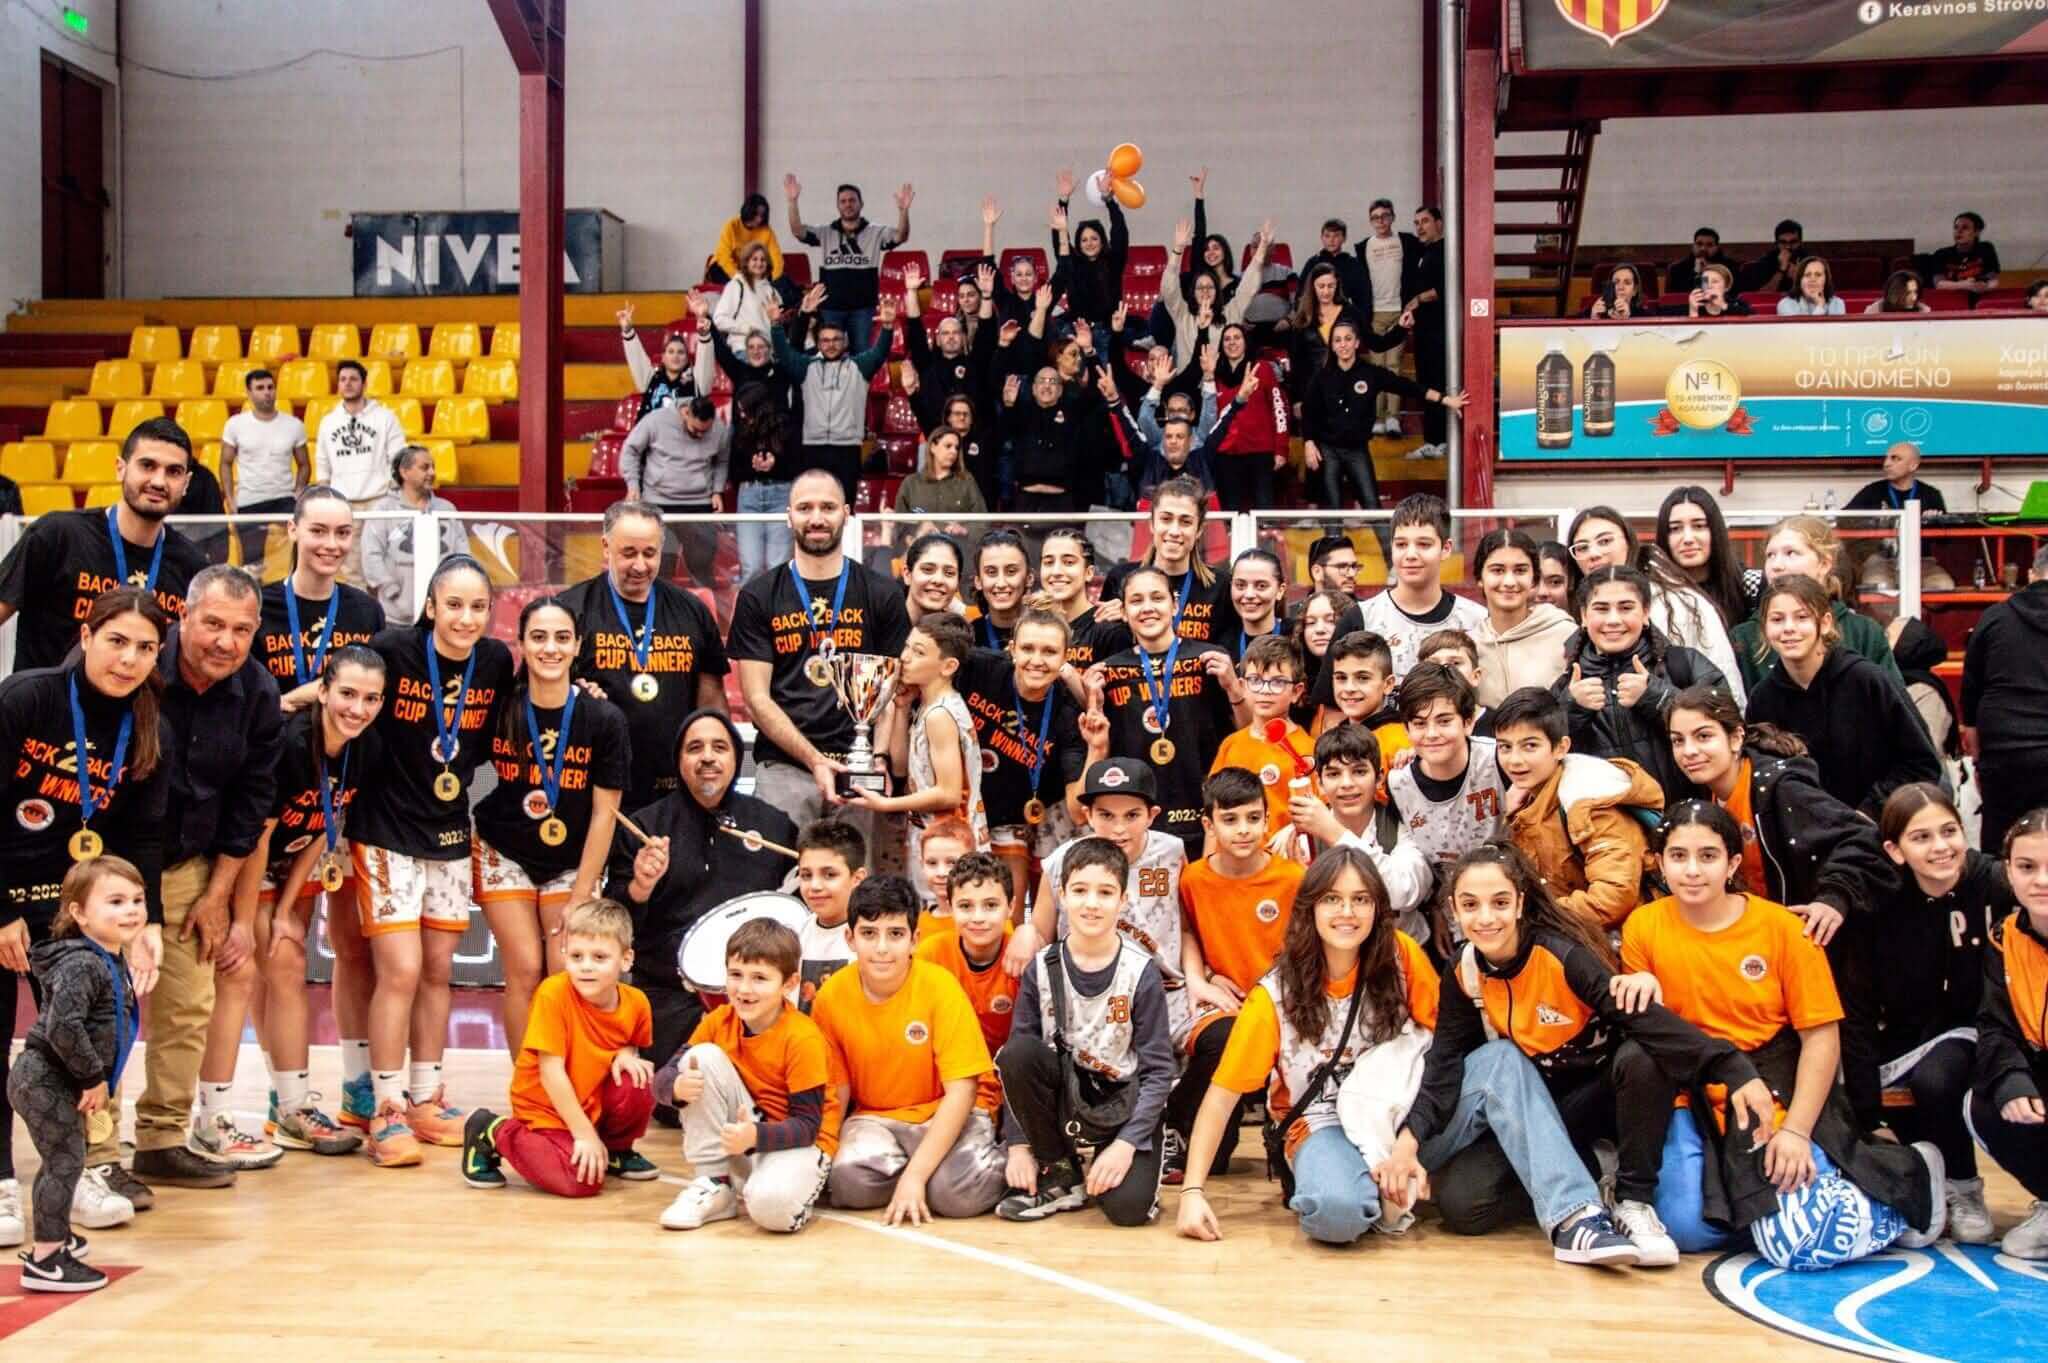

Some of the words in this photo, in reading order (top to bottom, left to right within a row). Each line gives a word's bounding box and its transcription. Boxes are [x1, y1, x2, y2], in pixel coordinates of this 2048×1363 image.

[1888, 2, 1977, 17] Keravnos
[1983, 0, 2048, 12] Strovo
[824, 253, 870, 265] adidas
[1844, 344, 1941, 366] ΠΡΟΟΝ
[1794, 368, 1951, 389] ΦΑΙΝΟΜΕΝΟ
[1271, 386, 1288, 433] adidas
[153, 588, 187, 616] ACK
[771, 611, 810, 632] BACK
[810, 597, 829, 625] 2
[1184, 603, 1213, 617] ACK
[1176, 620, 1210, 640] NERS
[653, 635, 692, 651] BACK
[775, 633, 802, 654] CUP
[595, 648, 626, 670] CUP
[628, 651, 694, 673] WNNERS
[1163, 658, 1202, 675] ACK
[398, 677, 437, 702] BAC
[443, 673, 463, 705] 2
[1138, 677, 1202, 702] WNNERS
[394, 698, 428, 723] CUP
[968, 691, 1006, 724] BACK
[22, 737, 61, 767] ACK
[540, 727, 560, 760] 2
[562, 745, 593, 765] ACK
[989, 728, 1041, 770] WINNER
[1466, 787, 1500, 822] 77
[1138, 867, 1169, 897] 28
